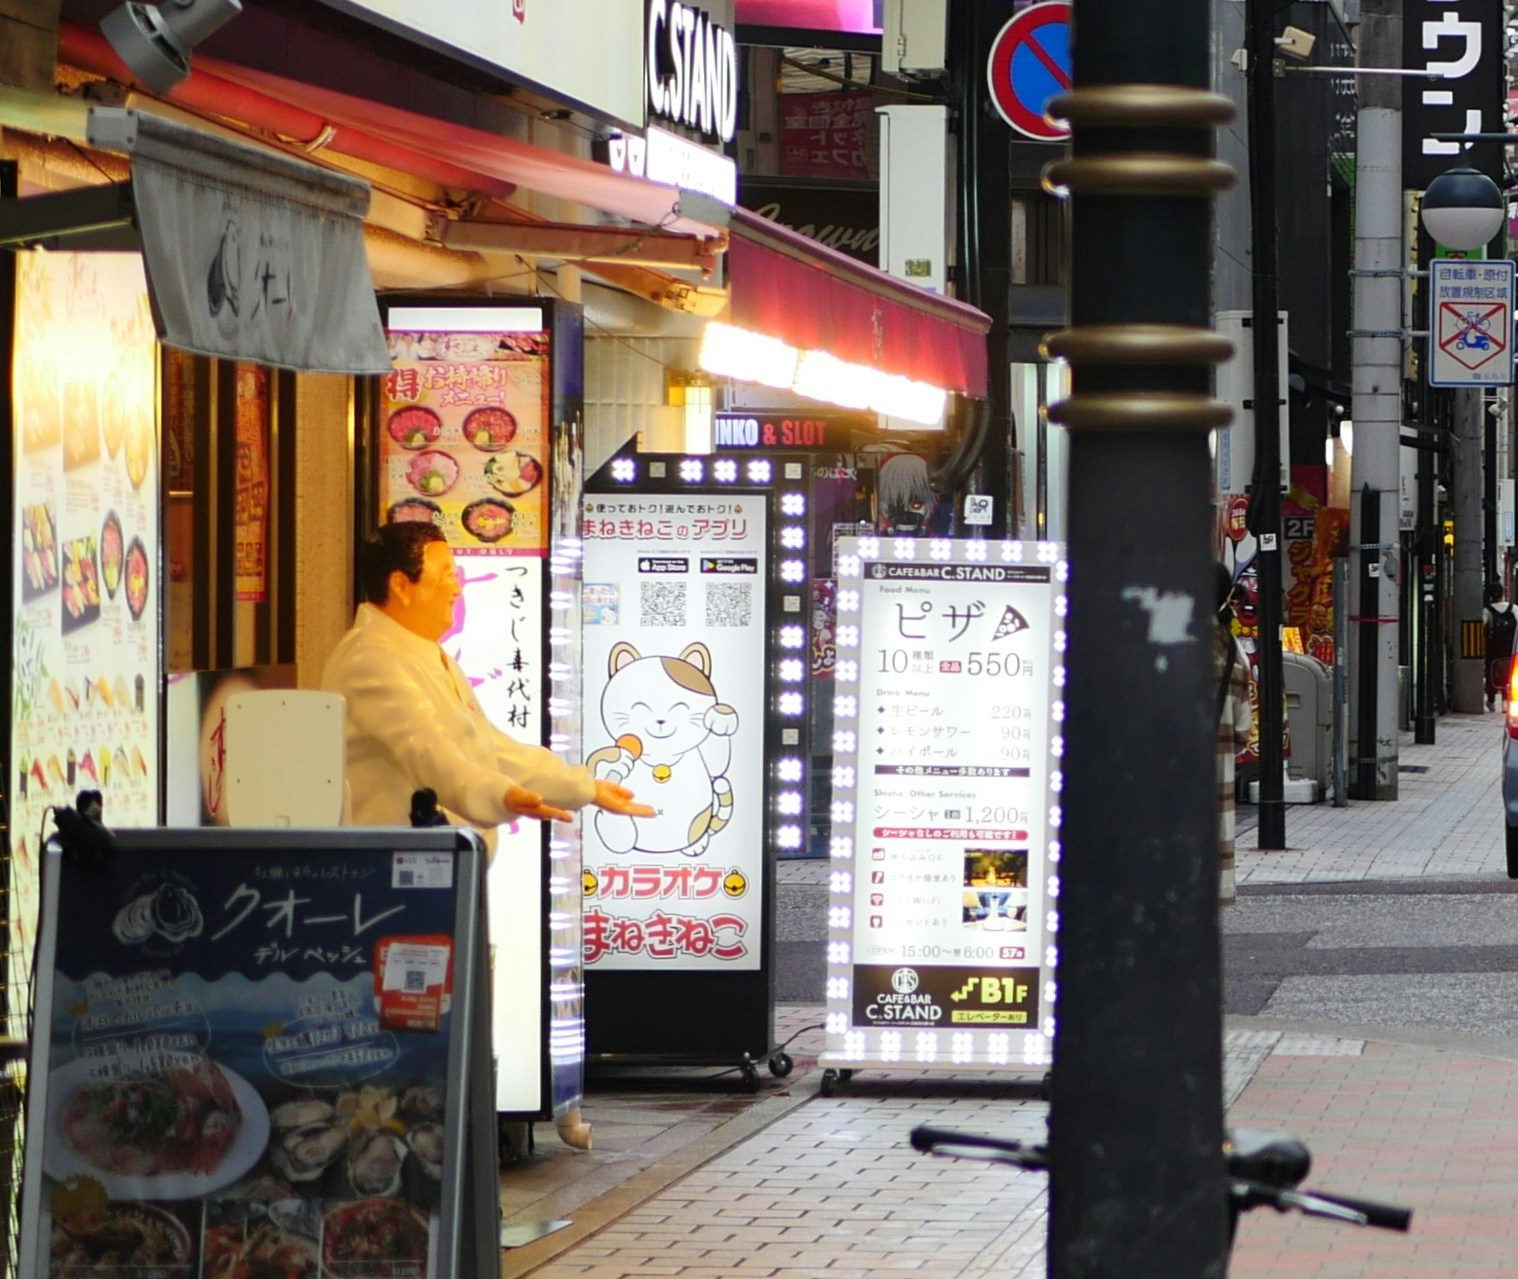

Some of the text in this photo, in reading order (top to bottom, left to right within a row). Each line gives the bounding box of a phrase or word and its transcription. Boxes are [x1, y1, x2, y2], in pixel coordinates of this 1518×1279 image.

[1439, 268, 1509, 281] 自転車・原付
[1439, 286, 1509, 299] 放置規制区域
[387, 368, 421, 402] 得
[763, 422, 777, 445] &
[781, 420, 826, 446] SLOT
[596, 503, 733, 515] 使っておトク!遊んでおトク!
[583, 519, 748, 539] まねきねこのアプリ
[651, 563, 687, 573] App Store
[715, 563, 756, 574] Google Play
[888, 566, 1006, 581] CAFE&BAR C.STAND
[879, 584, 932, 595] Food Menu
[894, 599, 987, 644] ピザ
[505, 565, 531, 730] つきじ喜代村
[877, 648, 909, 674] 10
[966, 652, 1021, 677] 550
[890, 703, 944, 718] 生ビール
[990, 705, 1022, 720] 220
[895, 765, 1012, 777] その他メニュー多数あります
[909, 789, 936, 799] Other
[938, 790, 977, 799] Services
[873, 804, 940, 822] シーシャ
[964, 806, 1020, 825] 1,200
[600, 865, 723, 898] カラオケ
[211, 882, 407, 941] クオーレ
[583, 906, 747, 962] まねきねこ
[980, 976, 1029, 1004] B1F
[876, 993, 932, 1005] CAFE&BAR
[865, 1004, 943, 1021] C.STAND
[957, 1013, 1023, 1022] エレベーターあり
